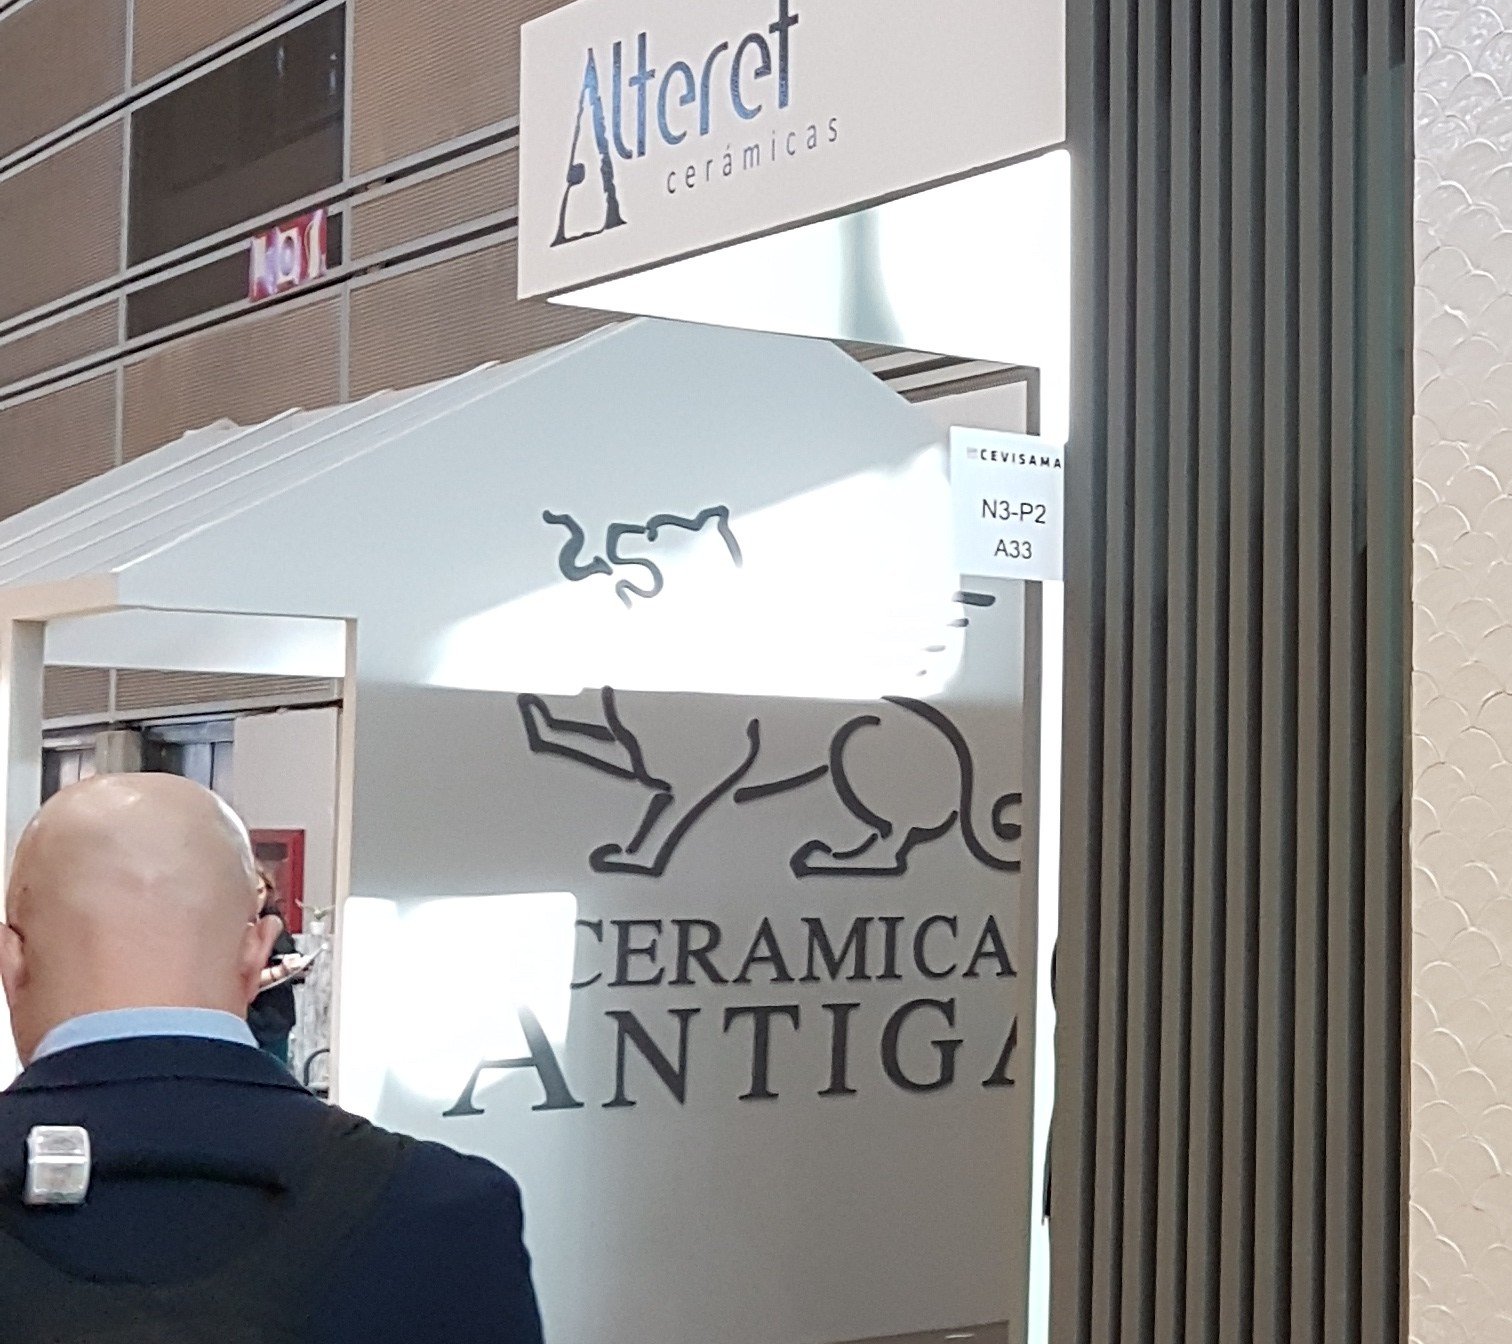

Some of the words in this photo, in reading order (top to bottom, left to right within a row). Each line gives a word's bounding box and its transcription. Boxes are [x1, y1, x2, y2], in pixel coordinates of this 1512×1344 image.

[666, 117, 839, 195] cerámicas
[980, 448, 1063, 469] CEVISAMA
[981, 498, 1047, 524] N3-P2
[993, 538, 1033, 560] A33
